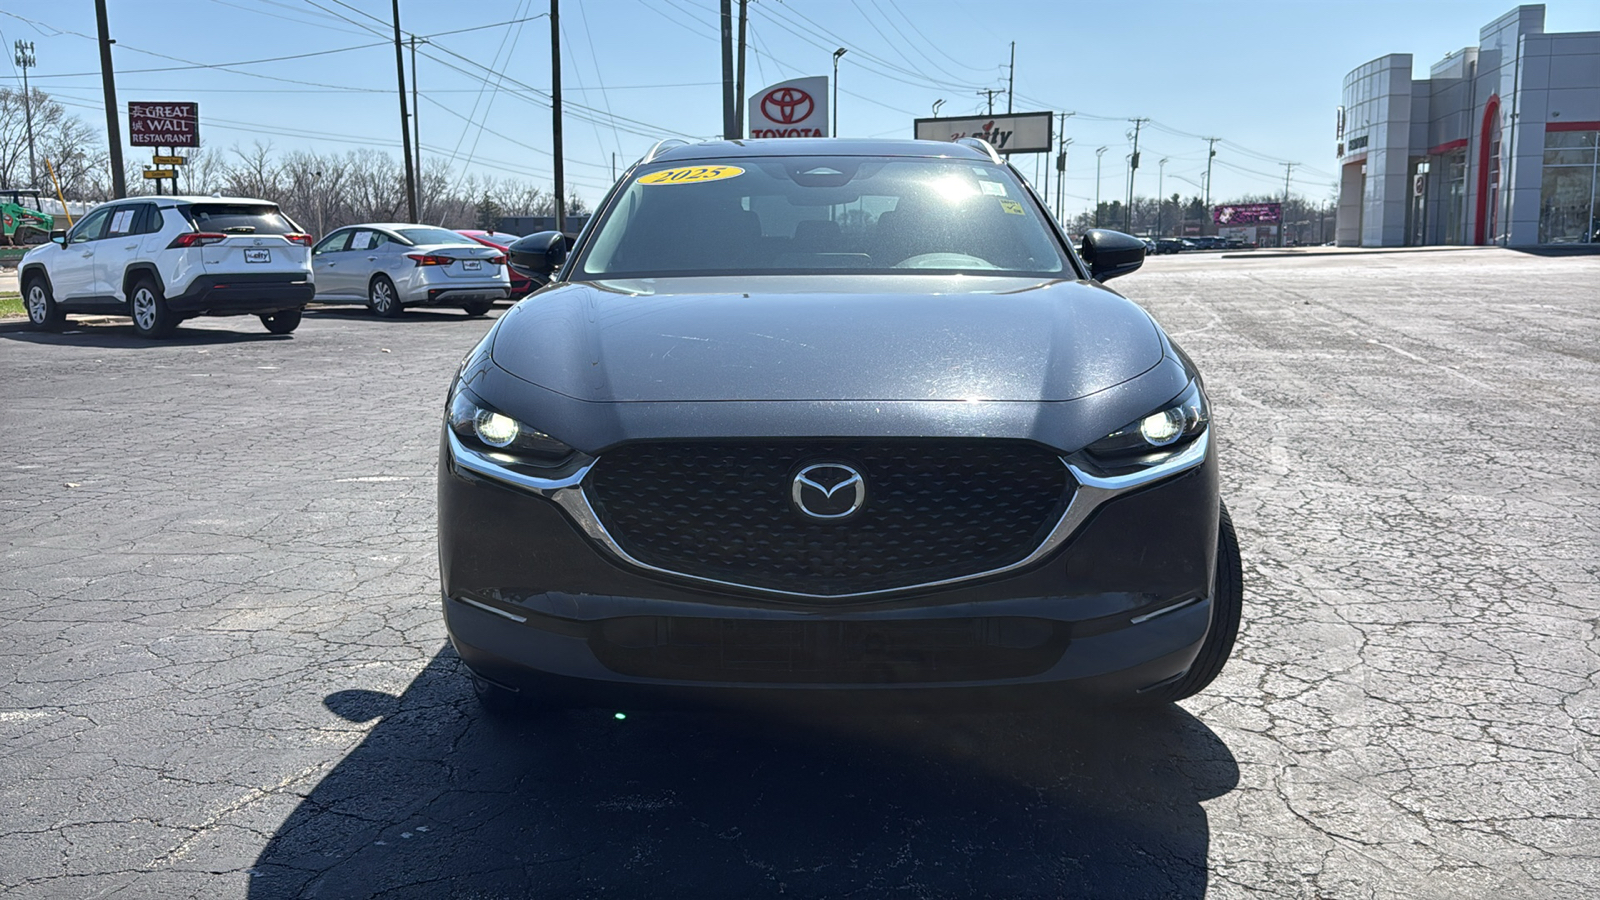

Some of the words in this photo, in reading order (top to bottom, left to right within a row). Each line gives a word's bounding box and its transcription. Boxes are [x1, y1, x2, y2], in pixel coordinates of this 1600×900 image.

[146, 106, 190, 117] GREAT
[147, 120, 189, 131] WALL
[132, 133, 192, 143] RESTAURANT
[651, 167, 727, 183] 2025
